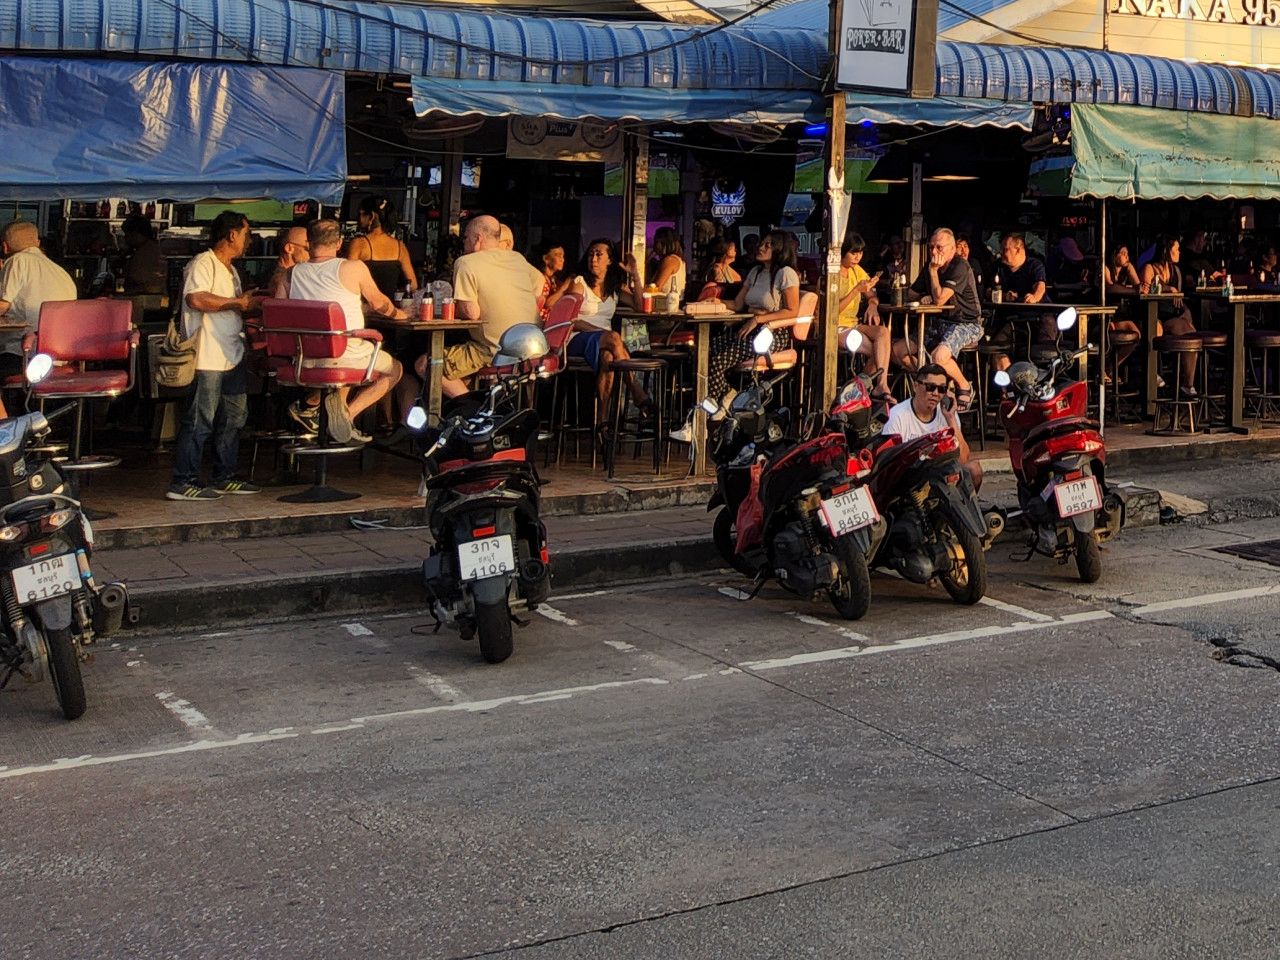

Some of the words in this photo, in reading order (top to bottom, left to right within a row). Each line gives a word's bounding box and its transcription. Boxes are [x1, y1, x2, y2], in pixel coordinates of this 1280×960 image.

[846, 28, 879, 50] POKER
[881, 29, 905, 53] BAR
[714, 205, 742, 216] KULOV
[1066, 499, 1094, 514] 9597
[838, 510, 870, 530] 8450
[469, 561, 507, 579] 4106
[27, 580, 73, 602] 6120
